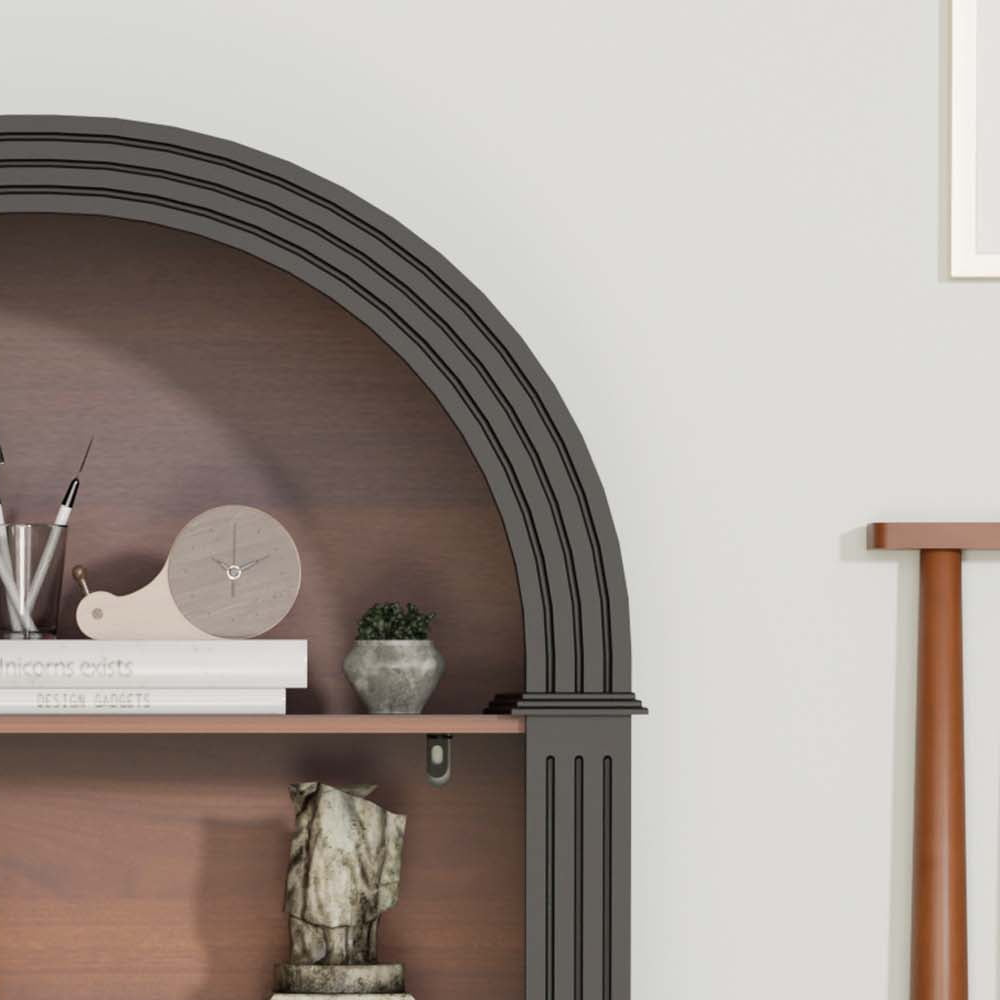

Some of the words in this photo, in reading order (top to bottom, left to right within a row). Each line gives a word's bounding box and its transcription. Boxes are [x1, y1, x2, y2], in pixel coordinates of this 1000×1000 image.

[79, 655, 134, 678] exists
[36, 693, 87, 709] DESIGN
[95, 693, 152, 709] GADGETS
